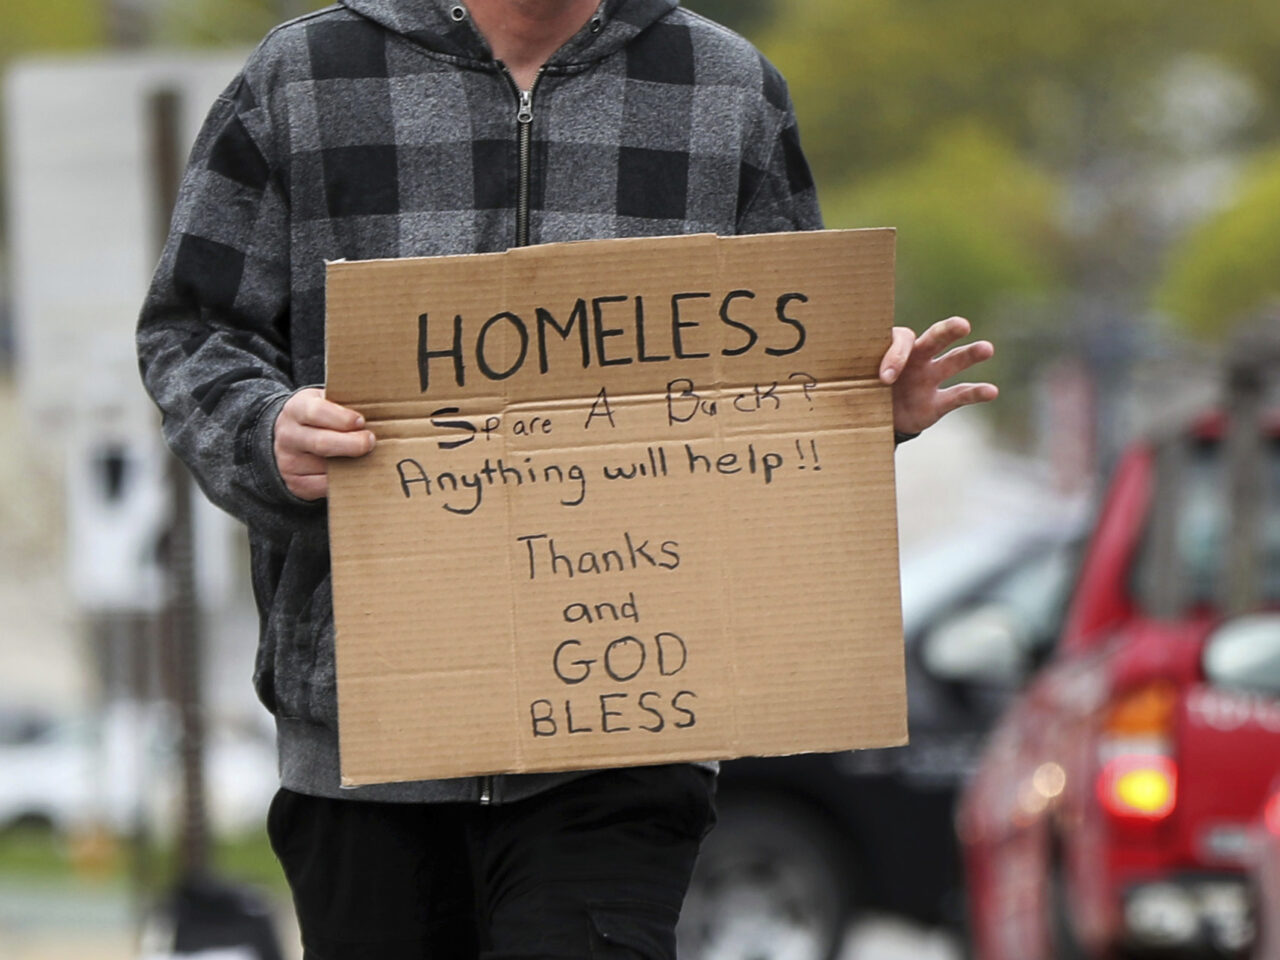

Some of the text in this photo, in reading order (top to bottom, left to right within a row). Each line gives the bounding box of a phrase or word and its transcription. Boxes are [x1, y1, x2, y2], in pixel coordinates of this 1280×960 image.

[416, 289, 810, 393] HOMELESS
[429, 405, 553, 450] Spare
[583, 385, 616, 430] A
[396, 438, 823, 516] Anything will help!!
[516, 531, 681, 580] Thanks
[562, 591, 640, 624] and
[552, 631, 688, 685] GOD
[529, 690, 698, 738] BLESS
